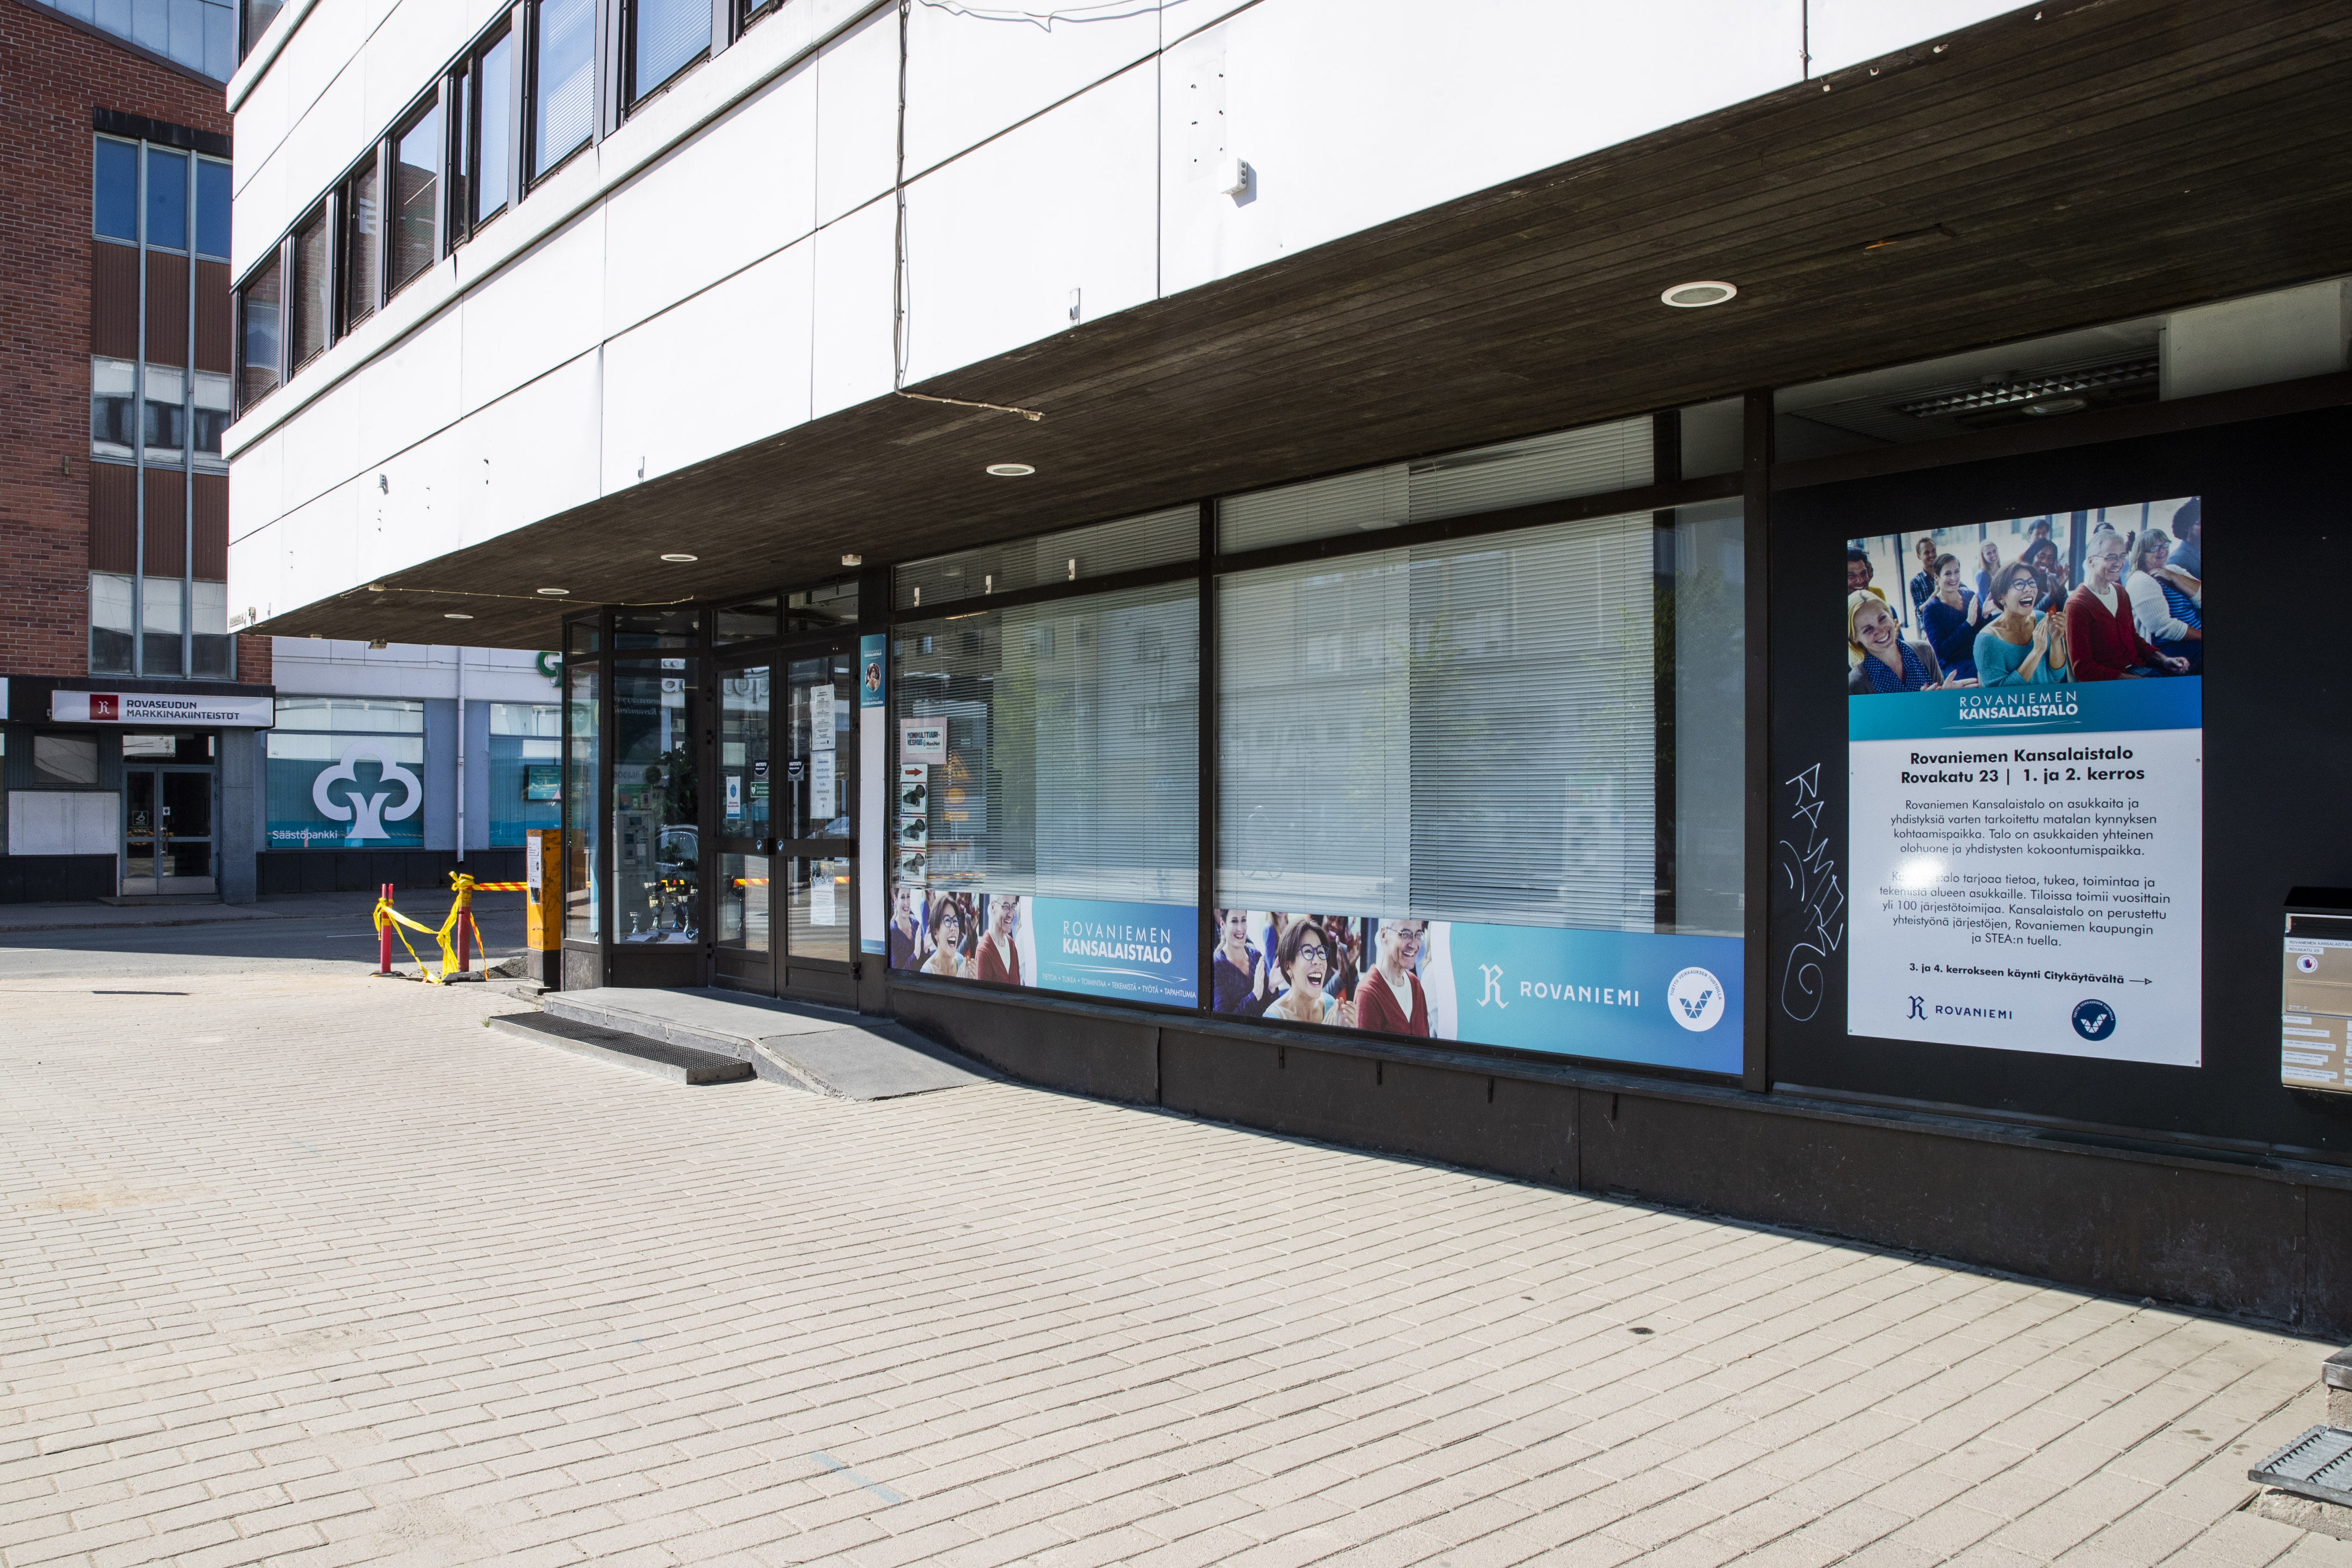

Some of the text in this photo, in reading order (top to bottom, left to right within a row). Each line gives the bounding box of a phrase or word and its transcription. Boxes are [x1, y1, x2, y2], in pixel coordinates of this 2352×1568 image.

[127, 700, 196, 709] ROVASEUDUN
[1960, 691, 2076, 707] ROVANIEMEN
[127, 710, 240, 720] MARKKINAKIINTEISTÖT
[1960, 703, 2078, 720] KANSALAISTALO
[1911, 745, 2133, 764] Rovaniemen Kansalaistalo
[1901, 770, 1973, 784] Rovakatu
[1979, 770, 1999, 782] 23
[2023, 769, 2037, 781] 1.
[2044, 768, 2059, 784] ja
[2065, 768, 2081, 781] 2.
[2088, 767, 2145, 780] kerros
[1906, 800, 1968, 809] Rovaniemen
[1973, 798, 2045, 809] Kansalaistalo
[2068, 798, 2123, 808] asukkaita
[2128, 798, 2138, 811] ja
[1891, 813, 2156, 826] yhdistyksiä varten tarkoitettu matalan kynnyksen
[272, 830, 338, 842] Säästöpankki
[1894, 828, 1985, 841] kohtaamispaikka.
[1989, 828, 2011, 839] Talo
[2033, 828, 2098, 839] asukkaiden
[2102, 828, 2153, 842] yhteinen
[1900, 843, 2144, 858] olohuone ja yhdistysten kokoontumispaikka.
[1962, 873, 2001, 887] tarjoaa
[2005, 874, 2039, 886] tietoa,
[2043, 874, 2078, 887] tukea,
[2082, 876, 2139, 887] toimintaa
[2144, 877, 2155, 890] ja
[1931, 886, 1965, 897] alueen
[1969, 888, 2026, 899] asukkaille.
[2030, 889, 2072, 900] Tiloissa
[2076, 891, 2108, 901] toimii
[2113, 892, 2170, 903] vuosittain
[1883, 899, 1893, 912] yli
[1898, 900, 1917, 910] 100
[1921, 901, 2004, 915] järjestötoimijaa.
[2009, 904, 2084, 916] Kansalaistalo
[2108, 909, 2166, 922] perustettu
[1064, 921, 1170, 944] ROVANIEMEN
[1893, 914, 2153, 937] yhteistyönä järjestöjen, Rovaniemen kaupungin
[1972, 932, 2061, 946] ja STEA:n tuella.
[1063, 938, 1172, 964] KANSALAISTALO
[1909, 963, 1918, 971] 3.
[1922, 964, 1931, 973] ja
[1946, 965, 2004, 976] kerrokseen
[2007, 968, 2040, 980] käynti
[2044, 971, 2124, 984] Citykäytävältä
[1081, 978, 1106, 987] TOIMINTAA
[1112, 982, 1136, 991] TEKEMISTÄ
[1142, 985, 1158, 994] TYÖTÄ
[1164, 988, 1196, 998] TAPAHTUMIA
[1670, 970, 1722, 1000] TUETTU VEIKKAUKSEN TUOTOILLA
[1521, 981, 1638, 1007] ROVANIEMI
[1936, 1005, 2012, 1020] ROVANIEMI
